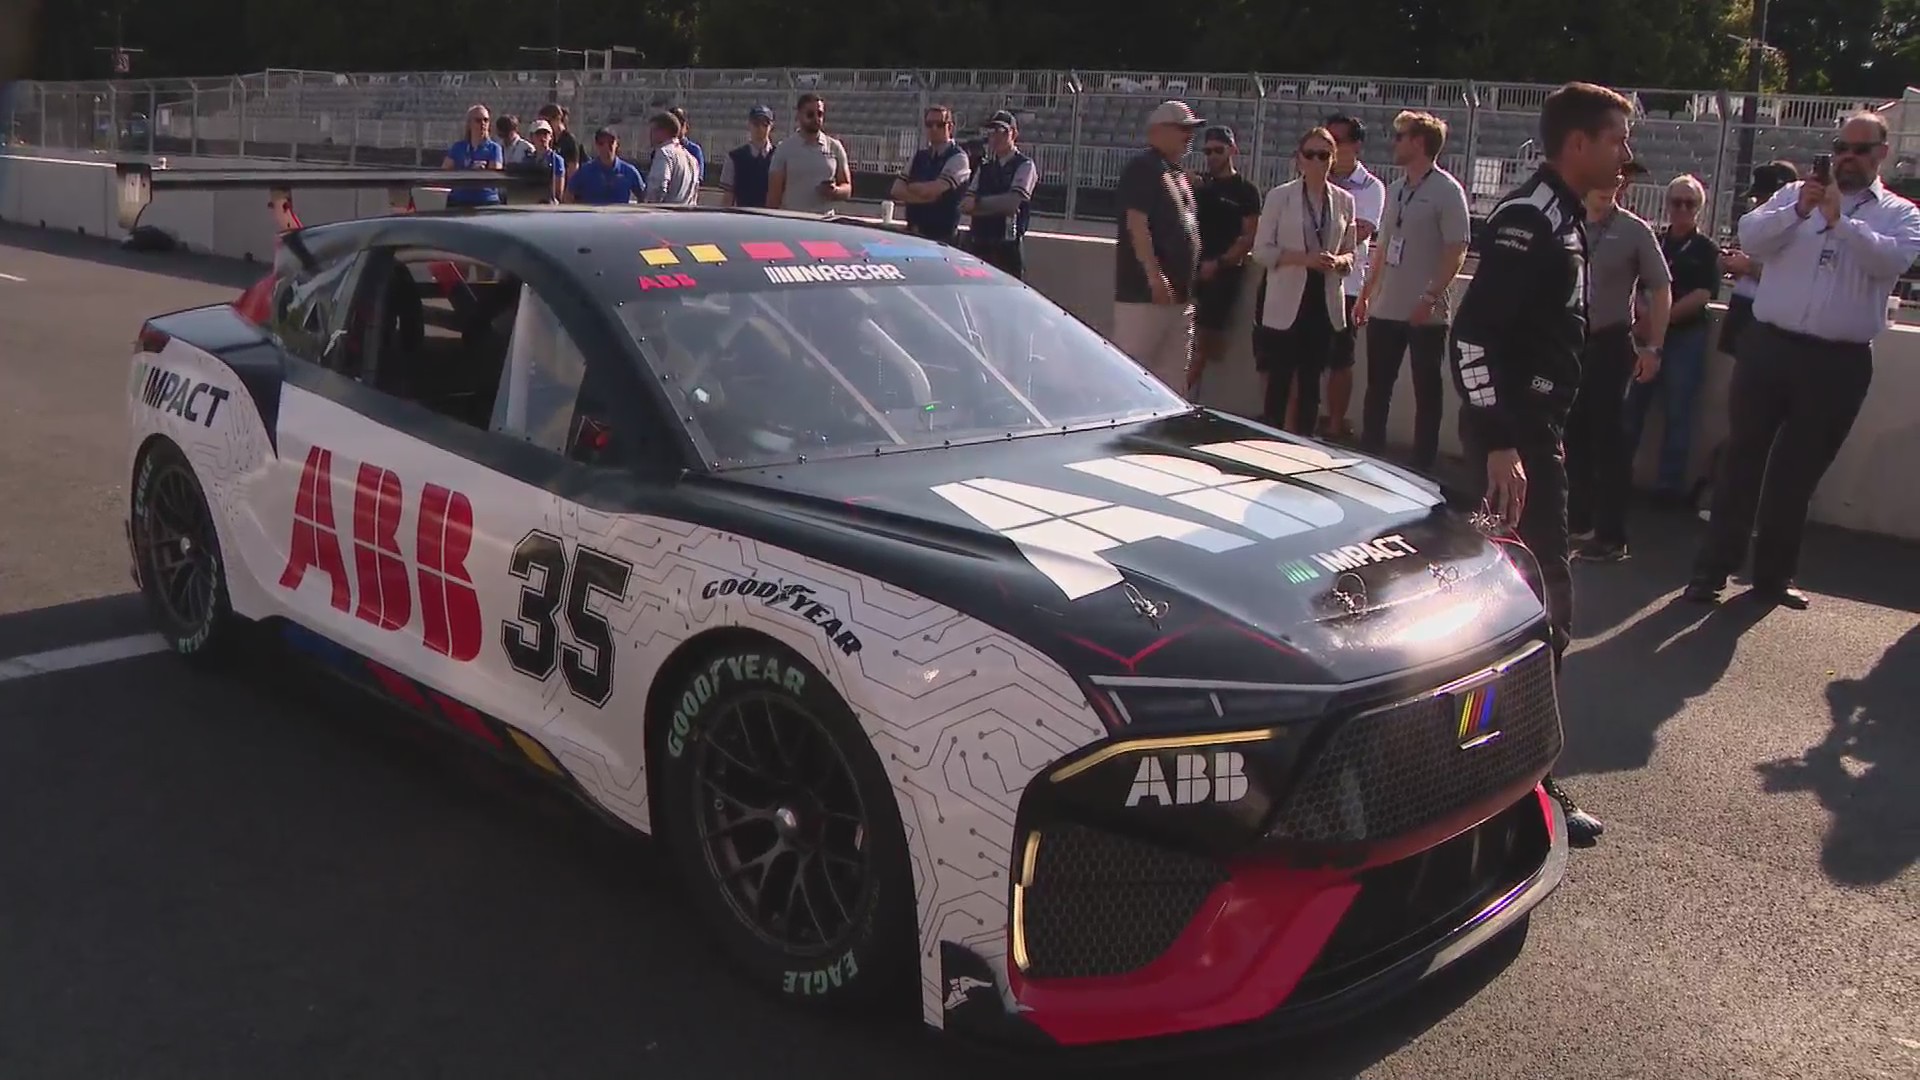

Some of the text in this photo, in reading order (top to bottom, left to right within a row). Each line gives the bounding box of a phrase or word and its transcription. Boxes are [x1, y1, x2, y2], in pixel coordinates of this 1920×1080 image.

[638, 272, 697, 291] ABB
[797, 264, 906, 283] NASCAR
[142, 366, 230, 428] IMPACT
[1456, 340, 1497, 408] ABB
[929, 440, 1447, 601] ABB
[279, 446, 483, 663] ABB
[1314, 534, 1420, 573] IMPACT
[501, 529, 633, 709] 35
[702, 577, 863, 658] GOODYEAR
[667, 654, 806, 759] GOODYEAR
[1125, 751, 1250, 807] ABB
[781, 948, 859, 995] EAGLE
